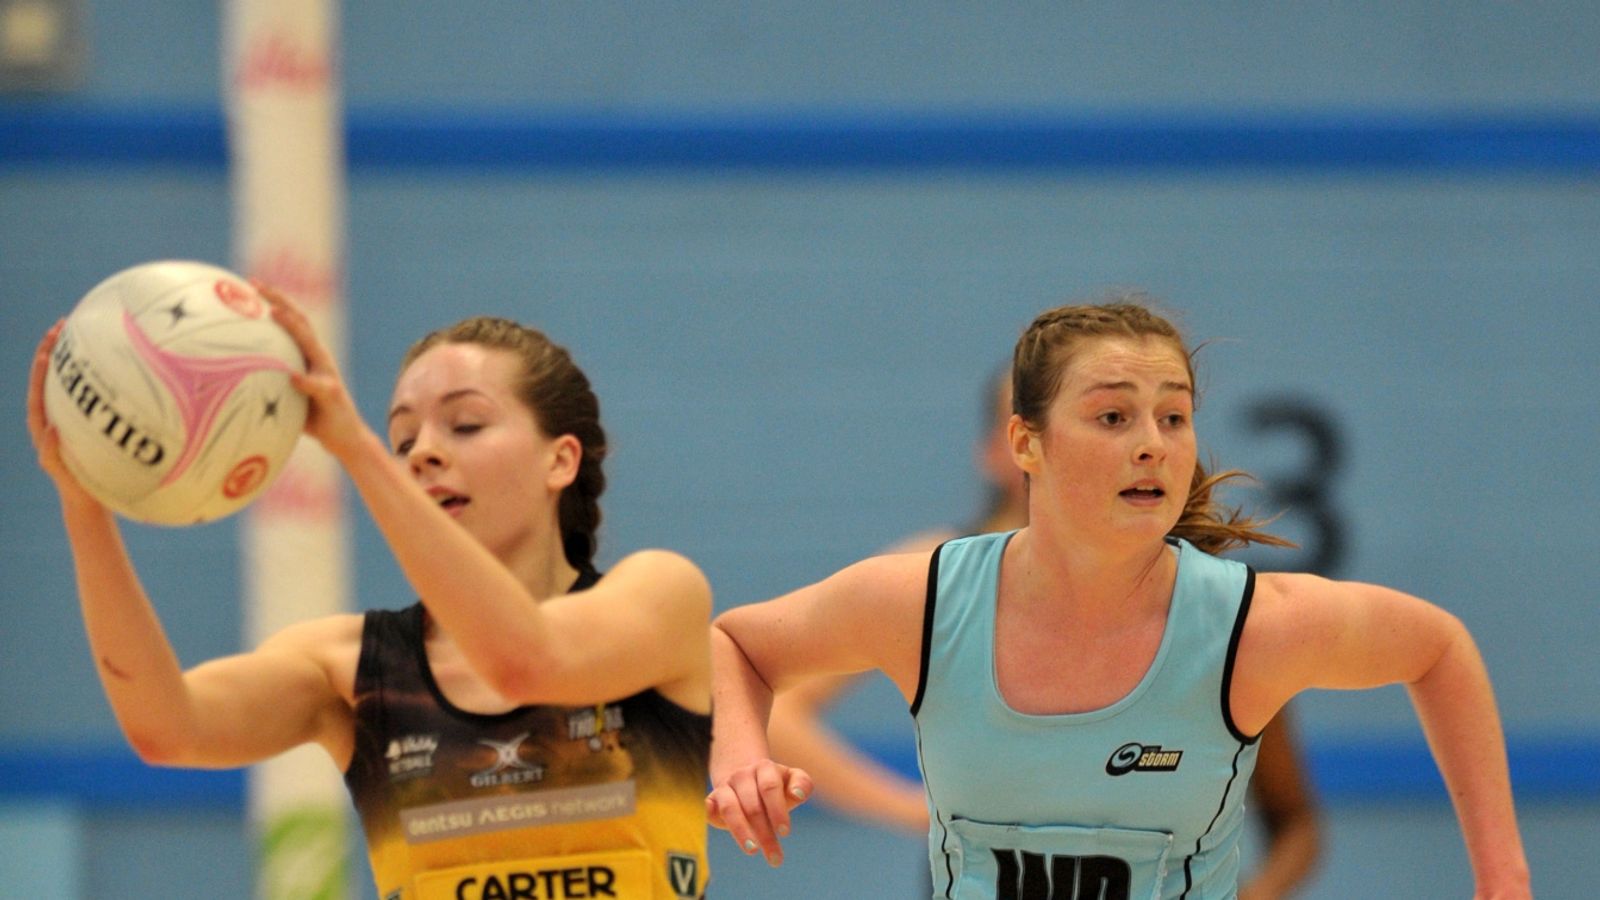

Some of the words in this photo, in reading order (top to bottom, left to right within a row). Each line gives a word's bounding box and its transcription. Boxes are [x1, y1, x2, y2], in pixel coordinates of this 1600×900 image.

[54, 339, 165, 466] GILBER
[1238, 394, 1344, 573] 3
[479, 802, 547, 825] AEGIS
[551, 795, 628, 816] network
[456, 866, 616, 900] CARTER
